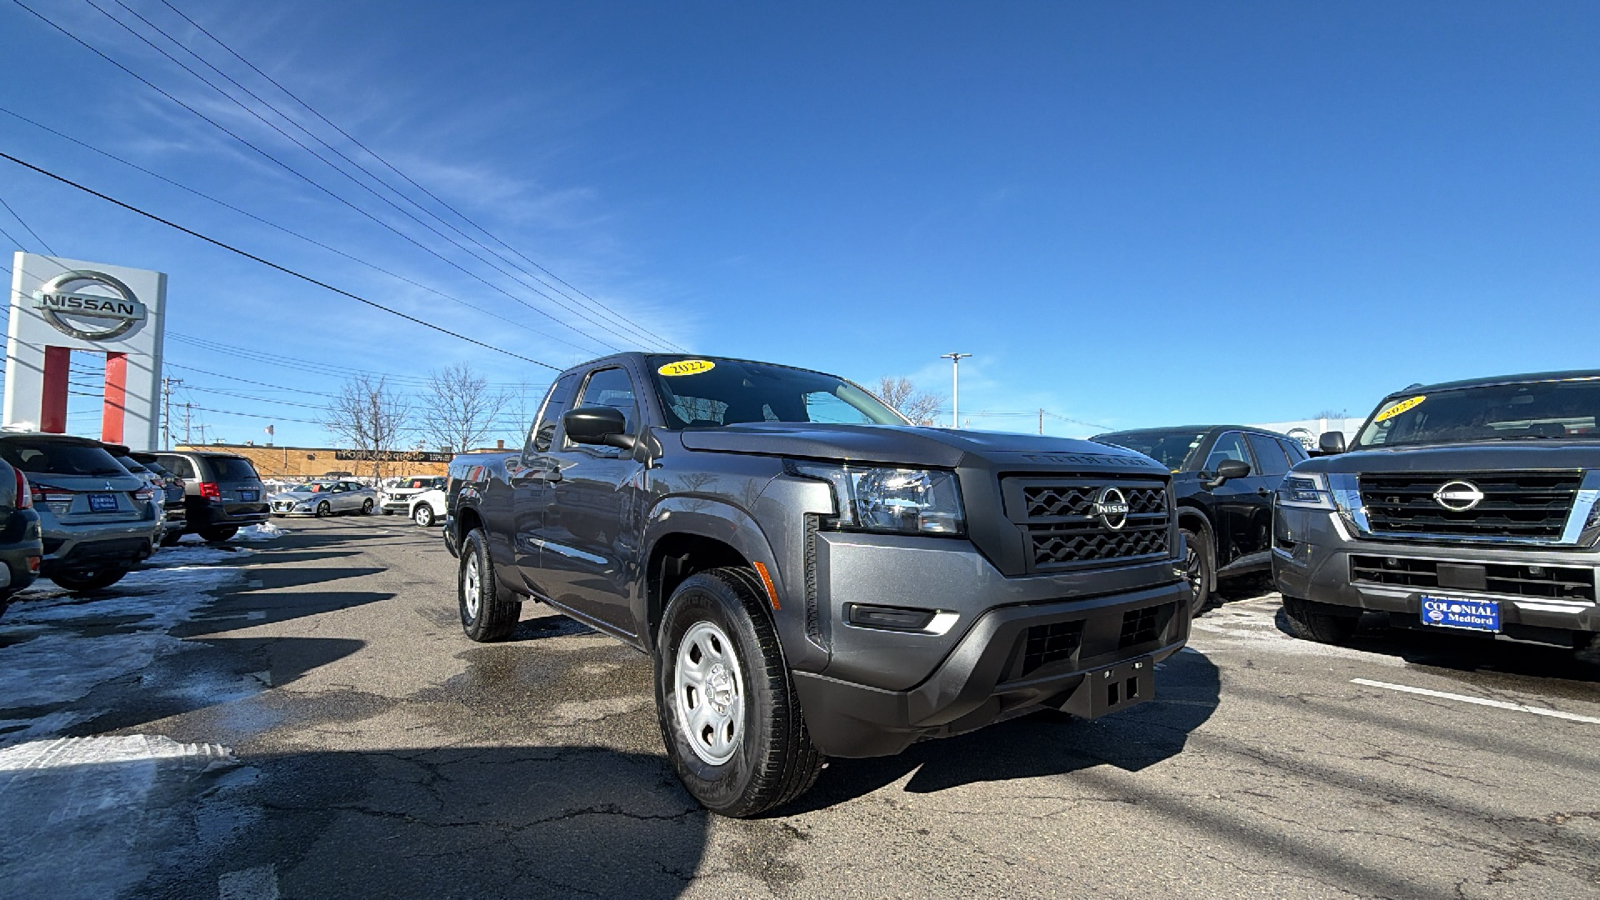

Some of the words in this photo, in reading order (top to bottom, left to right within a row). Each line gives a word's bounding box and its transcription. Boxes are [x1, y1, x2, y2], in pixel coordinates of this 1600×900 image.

[43, 294, 134, 315] NISSAN
[670, 361, 706, 374] 2022
[1385, 400, 1415, 418] 2022
[1424, 601, 1496, 616] COLONIAL
[1447, 613, 1494, 625] Medford
